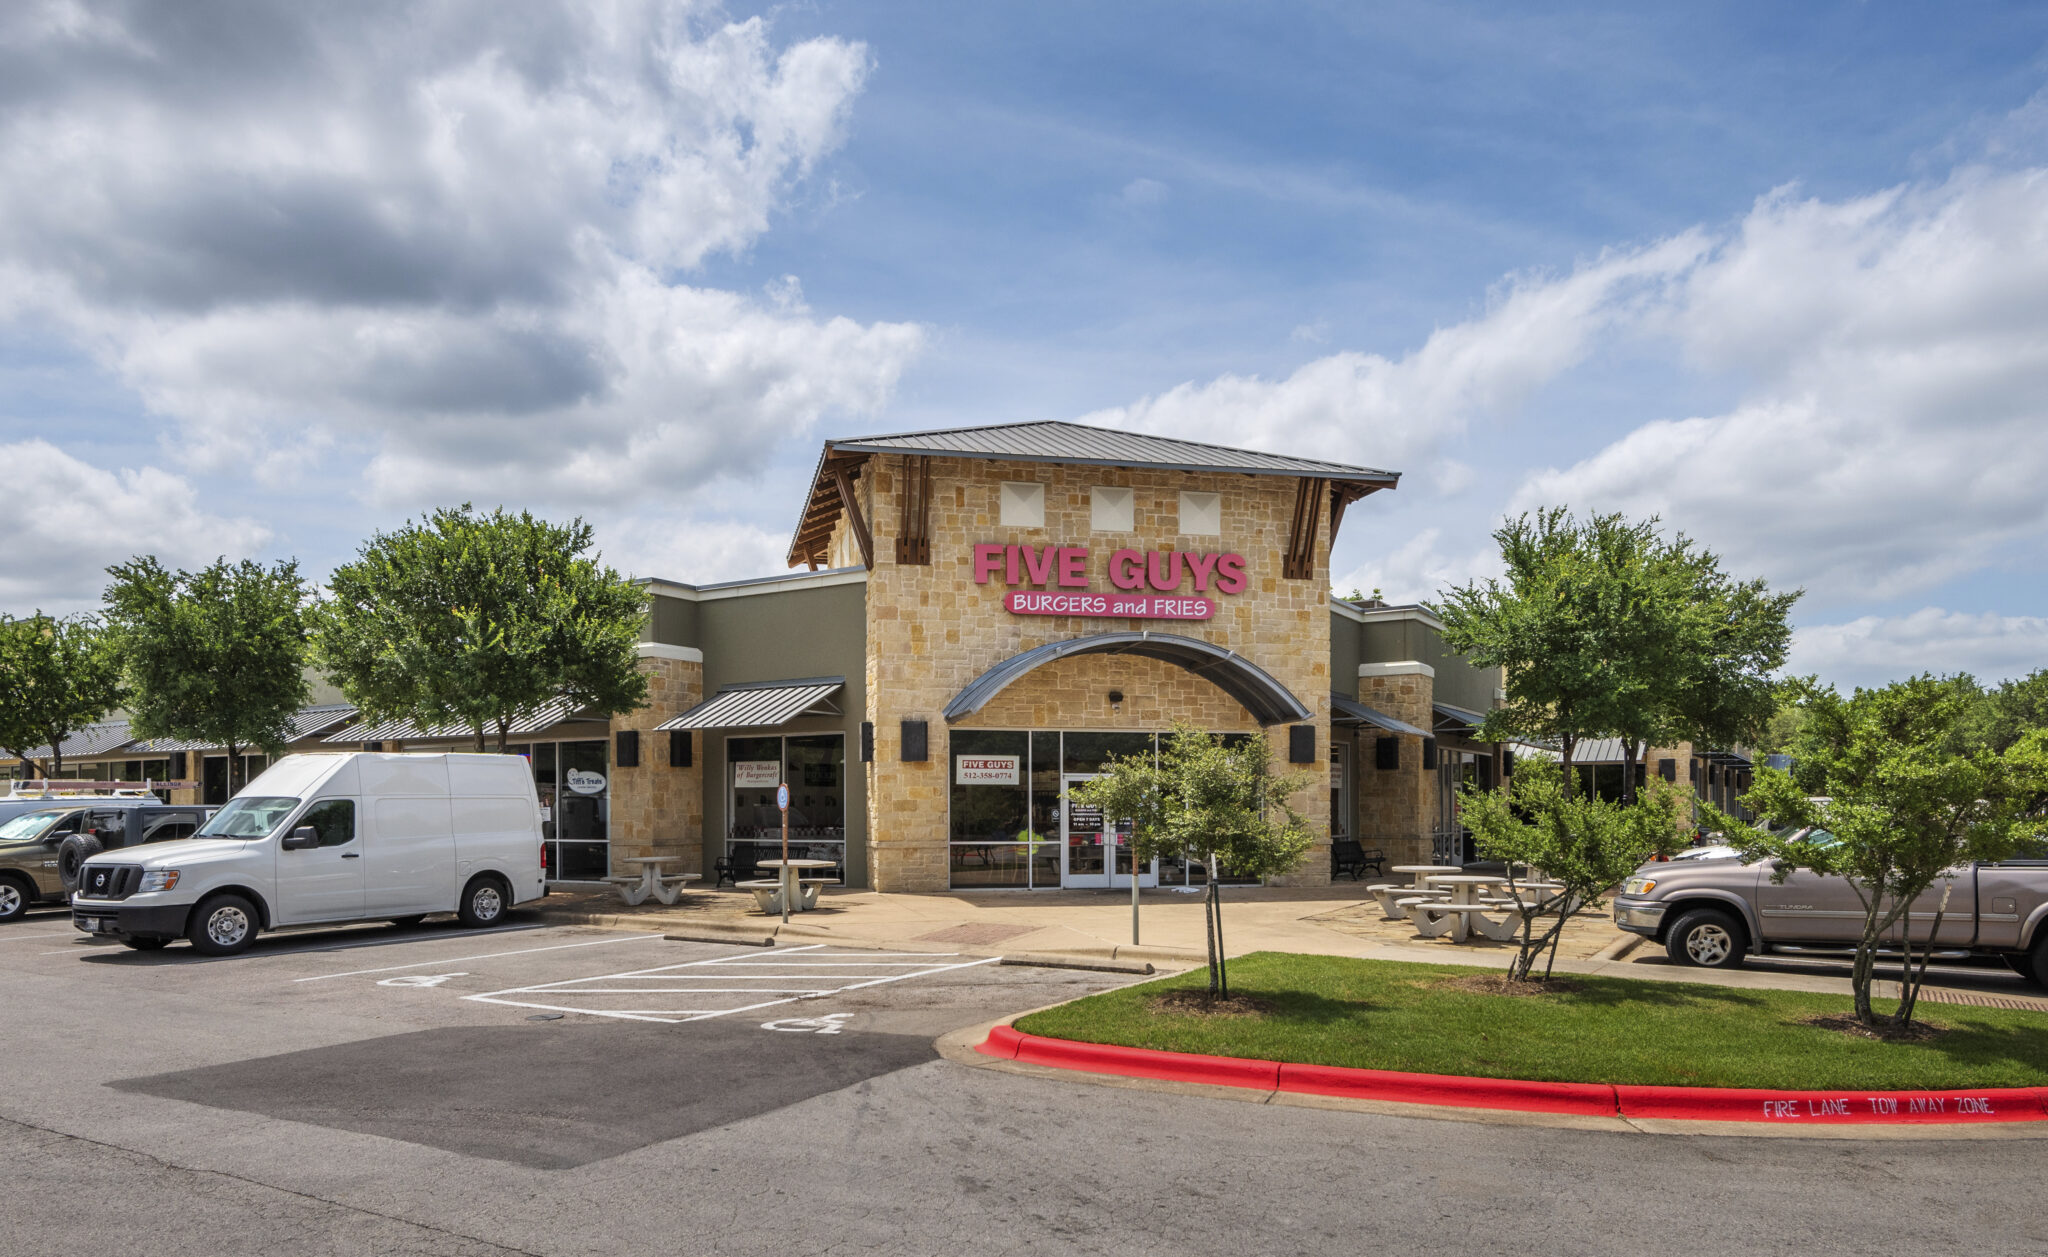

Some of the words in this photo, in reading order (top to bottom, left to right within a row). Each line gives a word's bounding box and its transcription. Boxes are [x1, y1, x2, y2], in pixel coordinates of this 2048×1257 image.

[974, 544, 1088, 587] FIVE
[1109, 549, 1248, 594] GUYS
[1013, 594, 1106, 613] BURGERS
[1112, 598, 1146, 614] and
[1154, 600, 1208, 616] FRIES
[1763, 1100, 1800, 1118] FIRE
[1808, 1098, 1851, 1117] LANE
[1868, 1098, 1898, 1114] TOW
[1909, 1098, 1945, 1113] AWAY
[1954, 1097, 1995, 1114] ZONE
